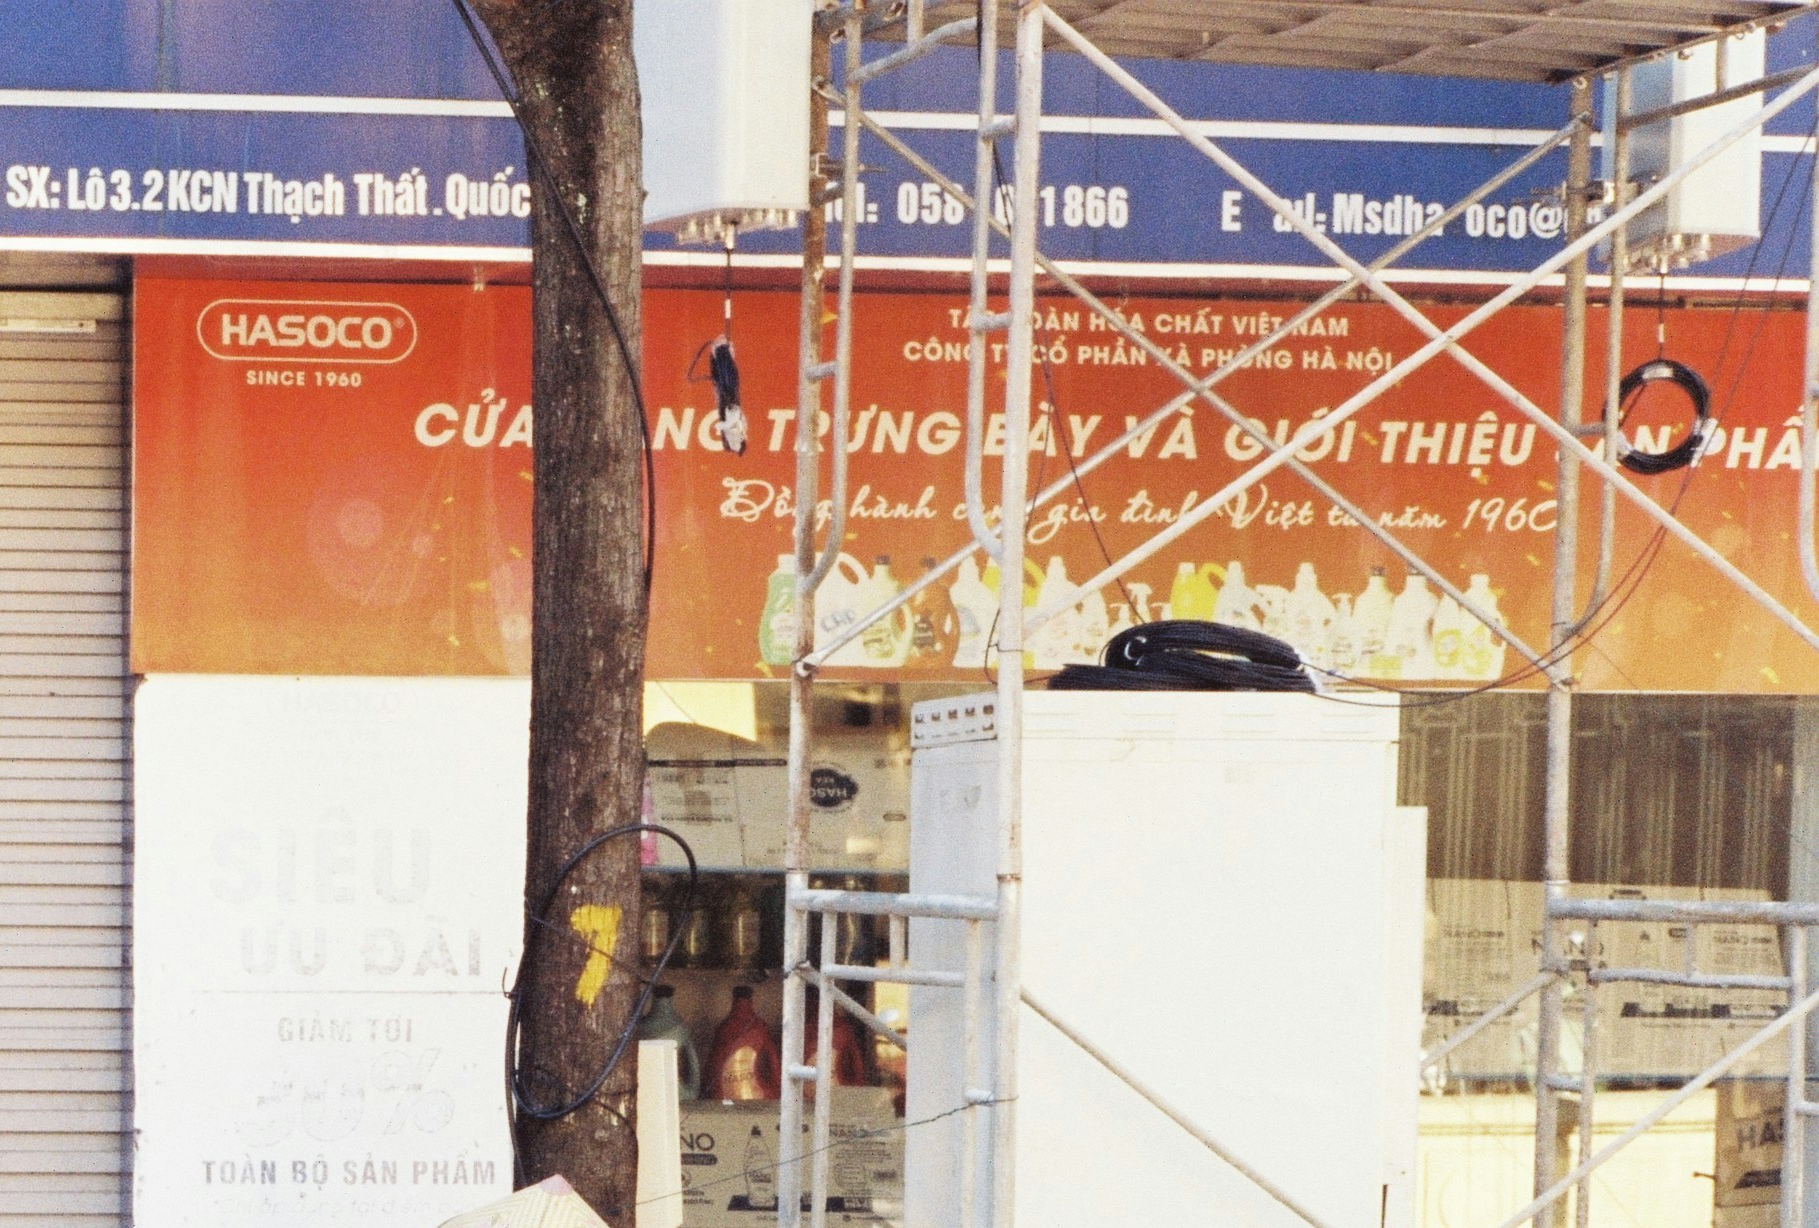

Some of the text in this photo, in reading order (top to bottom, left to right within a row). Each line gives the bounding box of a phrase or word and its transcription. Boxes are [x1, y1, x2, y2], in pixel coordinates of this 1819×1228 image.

[6, 165, 61, 209] SX:
[243, 172, 345, 224] Thạch
[221, 313, 393, 349] HASOCO
[1154, 307, 1224, 335] CHẤT
[1077, 336, 1147, 366] PHẦN
[1302, 345, 1337, 370] HÀ
[1346, 346, 1393, 376] NỘI
[246, 370, 363, 387] SINCE 1960
[1125, 403, 1198, 460] VÀ
[1379, 410, 1536, 477] THIỆU
[850, 484, 937, 519] hành
[211, 804, 433, 905] SIÊU
[202, 1147, 496, 1191] TOÀN BỘ SẢN PHẨM
